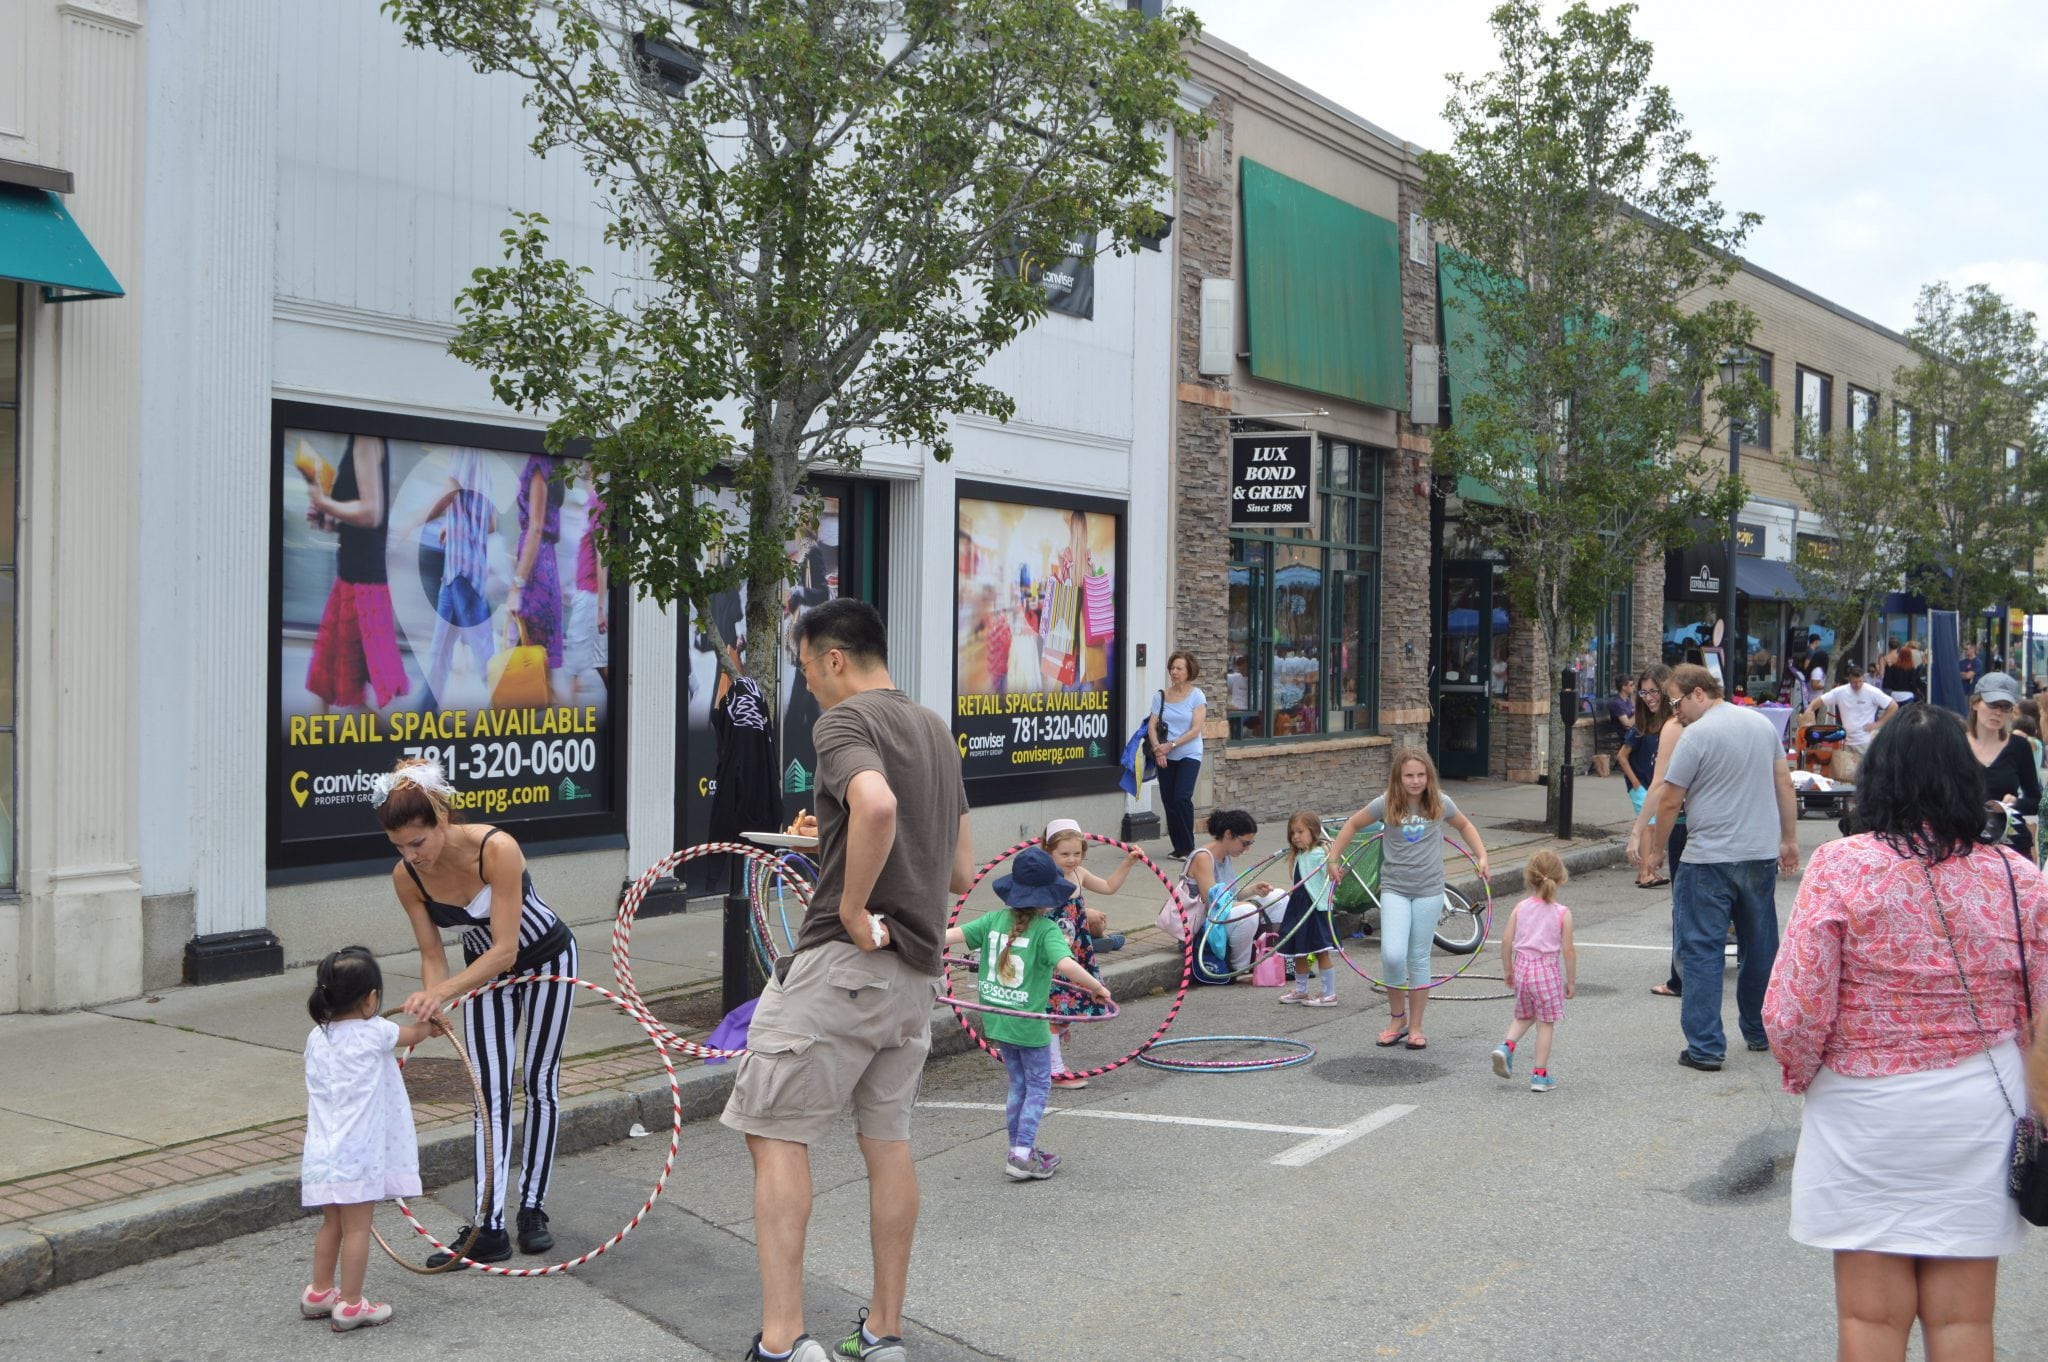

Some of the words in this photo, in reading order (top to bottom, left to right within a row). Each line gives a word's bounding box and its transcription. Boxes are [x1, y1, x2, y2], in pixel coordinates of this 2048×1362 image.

[1252, 447, 1289, 462] LUX
[1244, 466, 1296, 481] BOND
[1232, 485, 1247, 500] &
[1248, 485, 1307, 500] GREEN
[1246, 503, 1270, 513] Since
[1272, 503, 1293, 512] 1898
[958, 694, 1003, 716] RETAIL
[1005, 692, 1044, 714] SPACE
[1046, 690, 1109, 712] AVAILABLE
[290, 714, 382, 746] RETAIL
[390, 709, 467, 741] SPACE
[472, 706, 597, 738] AVAILABLE
[1011, 713, 1108, 744] 781-320-0600
[968, 732, 1006, 750] conviser
[1011, 745, 1085, 765] conviserpg.com
[313, 768, 390, 795] convise
[314, 794, 355, 806] PROPERTY
[448, 784, 549, 813] iserpg.com
[991, 985, 1029, 1003] SOCCER
